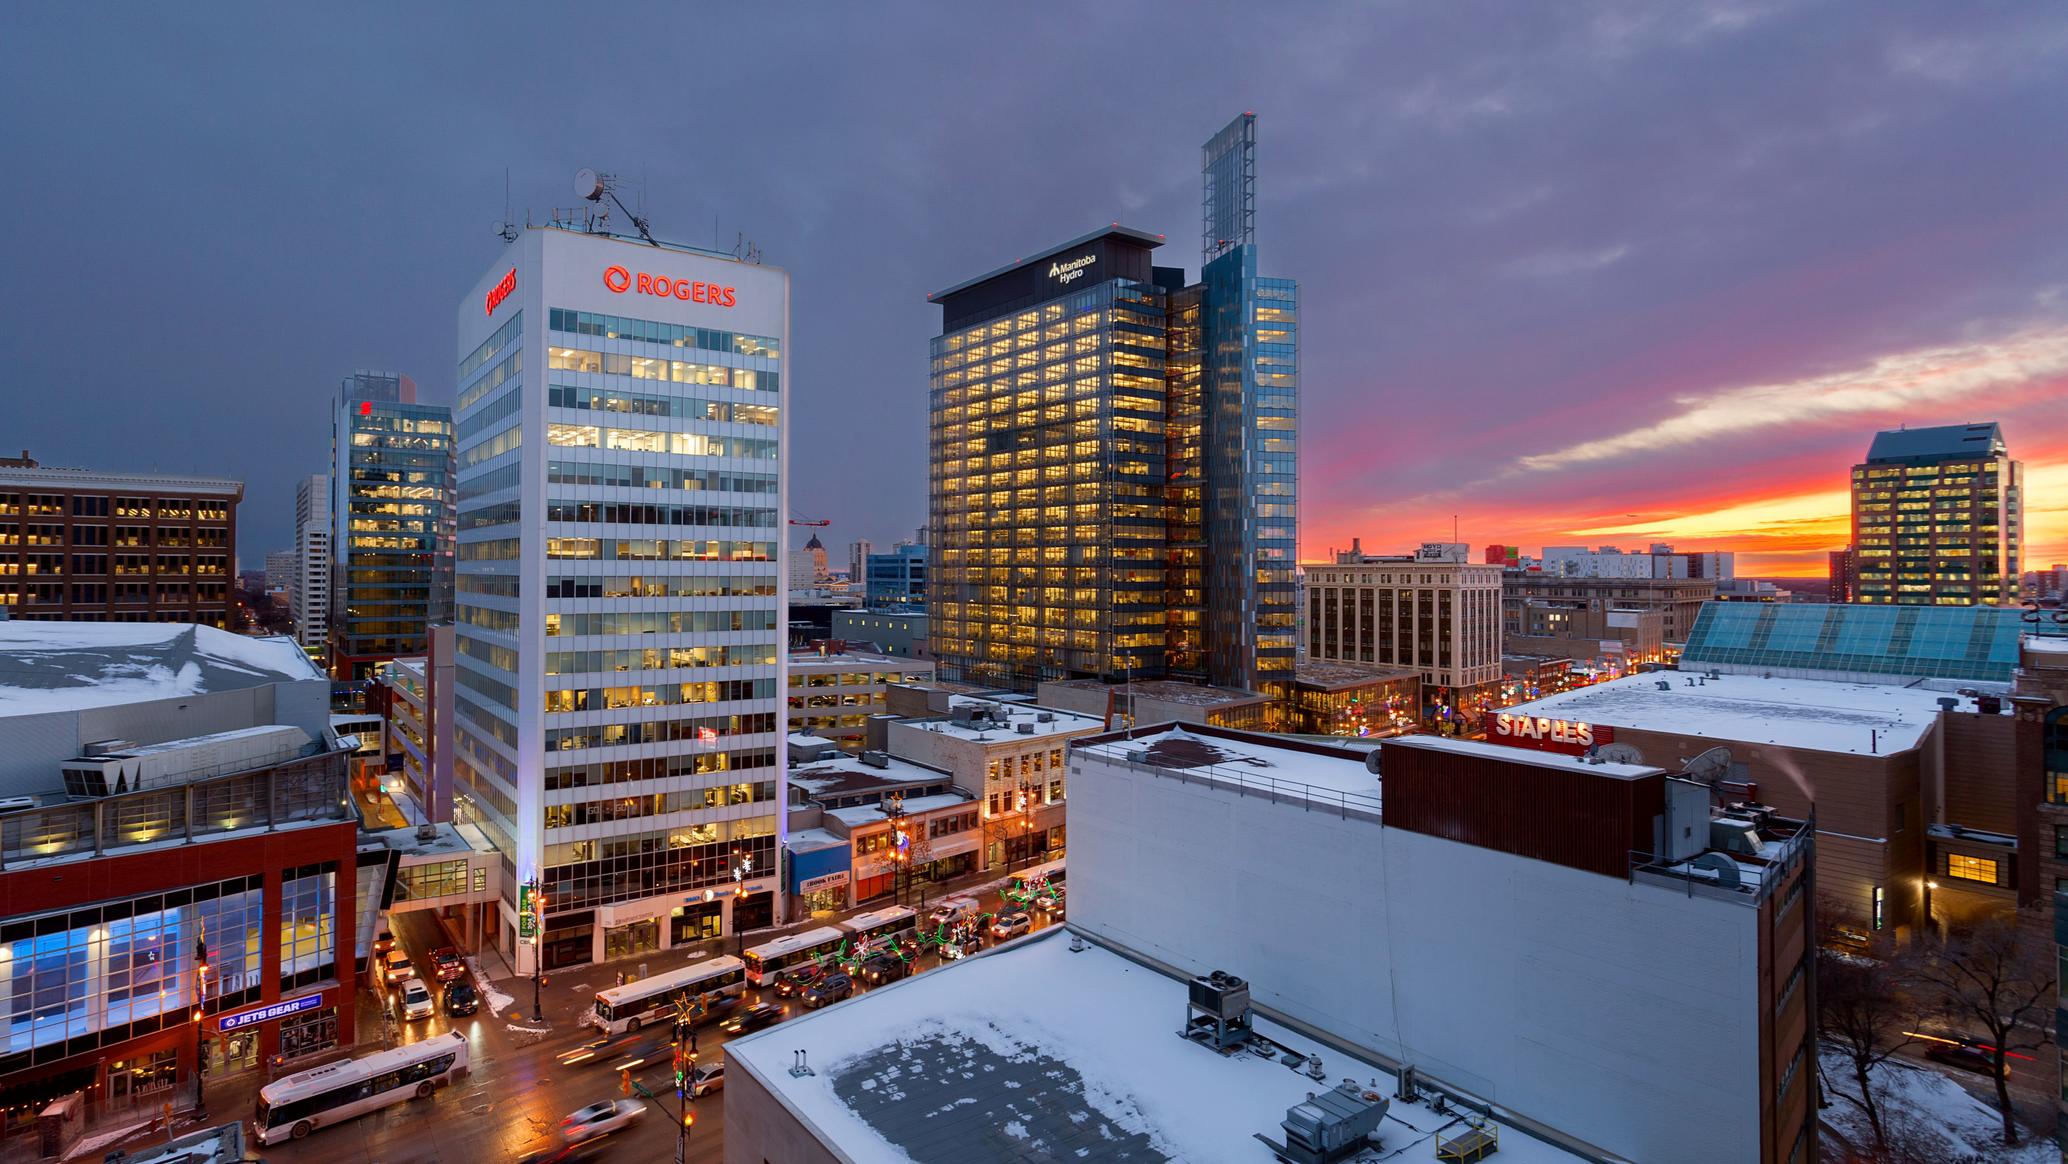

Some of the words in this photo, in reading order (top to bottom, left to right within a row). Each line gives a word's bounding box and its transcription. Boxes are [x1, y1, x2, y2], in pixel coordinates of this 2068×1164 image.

[1060, 255, 1096, 273] Manitoba
[1060, 269, 1083, 284] Hydro
[637, 272, 736, 307] ROGERS
[1496, 713, 1594, 746] STAPLES
[238, 1010, 267, 1025] JETS
[267, 1002, 300, 1017] GEAR
